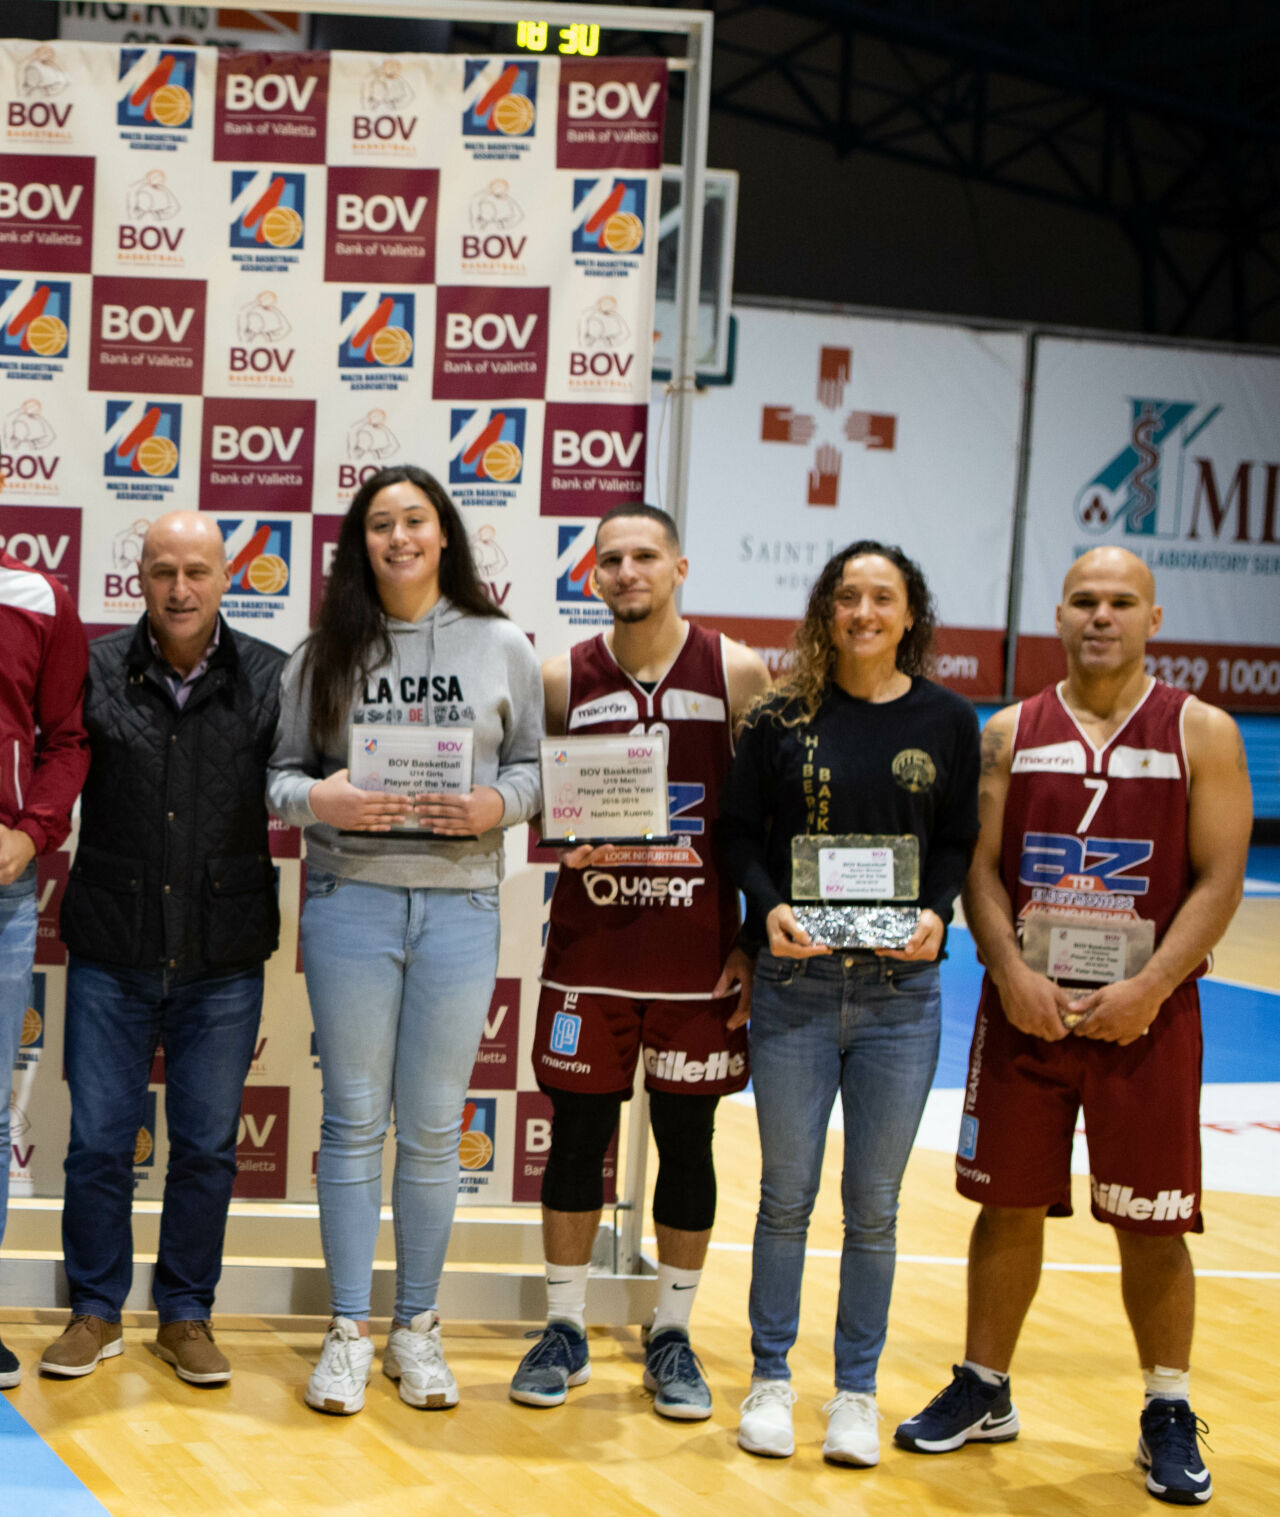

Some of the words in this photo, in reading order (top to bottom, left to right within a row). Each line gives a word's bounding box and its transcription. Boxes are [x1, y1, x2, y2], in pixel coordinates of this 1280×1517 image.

[226, 75, 317, 111] BOV
[568, 82, 659, 119] BOV
[8, 102, 72, 128] BOV
[224, 122, 254, 134] Bank
[256, 123, 269, 134] of
[272, 123, 316, 137] Valletta
[353, 115, 416, 140] BOV
[337, 195, 427, 232] BOV
[119, 225, 183, 251] BOV
[336, 243, 363, 255] Bank
[365, 243, 378, 255] of
[381, 244, 425, 257] Valletta
[462, 235, 526, 259] BOV
[102, 305, 194, 342] BOV
[446, 314, 537, 350] BOV
[100, 352, 129, 364] Bank
[131, 353, 144, 365] of
[147, 355, 193, 368] Valletta
[230, 347, 294, 372] BOV
[444, 361, 473, 373] Bank
[475, 361, 488, 373] of
[491, 361, 537, 373] Valletta
[570, 352, 633, 376] BOV
[212, 426, 303, 461] BOV
[553, 430, 643, 468] BOV
[1, 455, 60, 480] BOV
[1149, 548, 1248, 573] LABORATORY
[362, 677, 393, 705] LA
[400, 675, 464, 704] CASA
[409, 708, 423, 722] DE
[578, 702, 627, 718] macron
[438, 741, 463, 751] BOV
[627, 748, 653, 758] BOV
[412, 759, 460, 768] Basketball
[580, 768, 600, 777] BOV
[604, 767, 652, 776] Basketball
[577, 787, 604, 797] Player
[553, 807, 582, 819] BOV
[1076, 777, 1109, 834] 7
[1068, 875, 1095, 890] TO
[475, 1051, 507, 1064] lletta
[541, 1055, 591, 1074] macron
[644, 1047, 746, 1083] Gillette
[235, 1114, 277, 1148] OV
